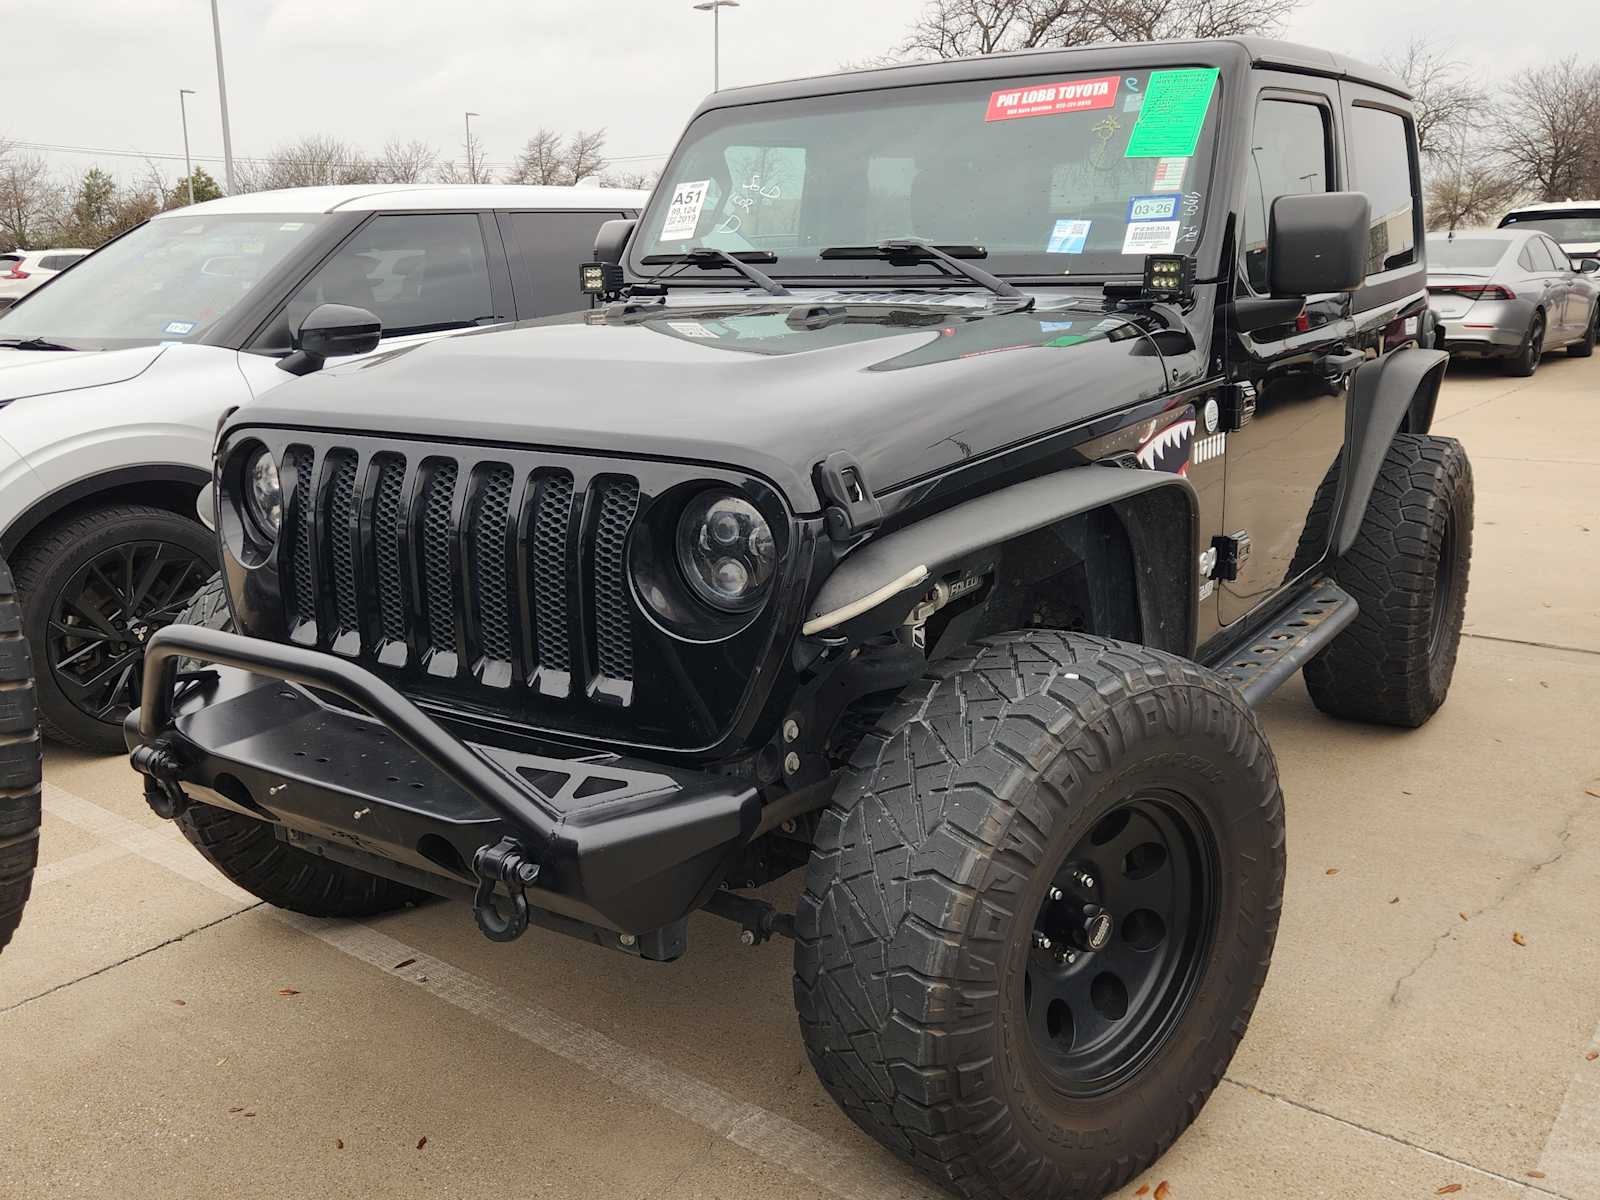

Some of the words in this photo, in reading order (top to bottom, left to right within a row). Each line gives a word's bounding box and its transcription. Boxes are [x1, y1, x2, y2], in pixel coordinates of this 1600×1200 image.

[997, 92, 1022, 107] PAT
[1022, 88, 1056, 103] LOBB
[1058, 82, 1108, 99] TOYOTA
[672, 189, 702, 206] A51
